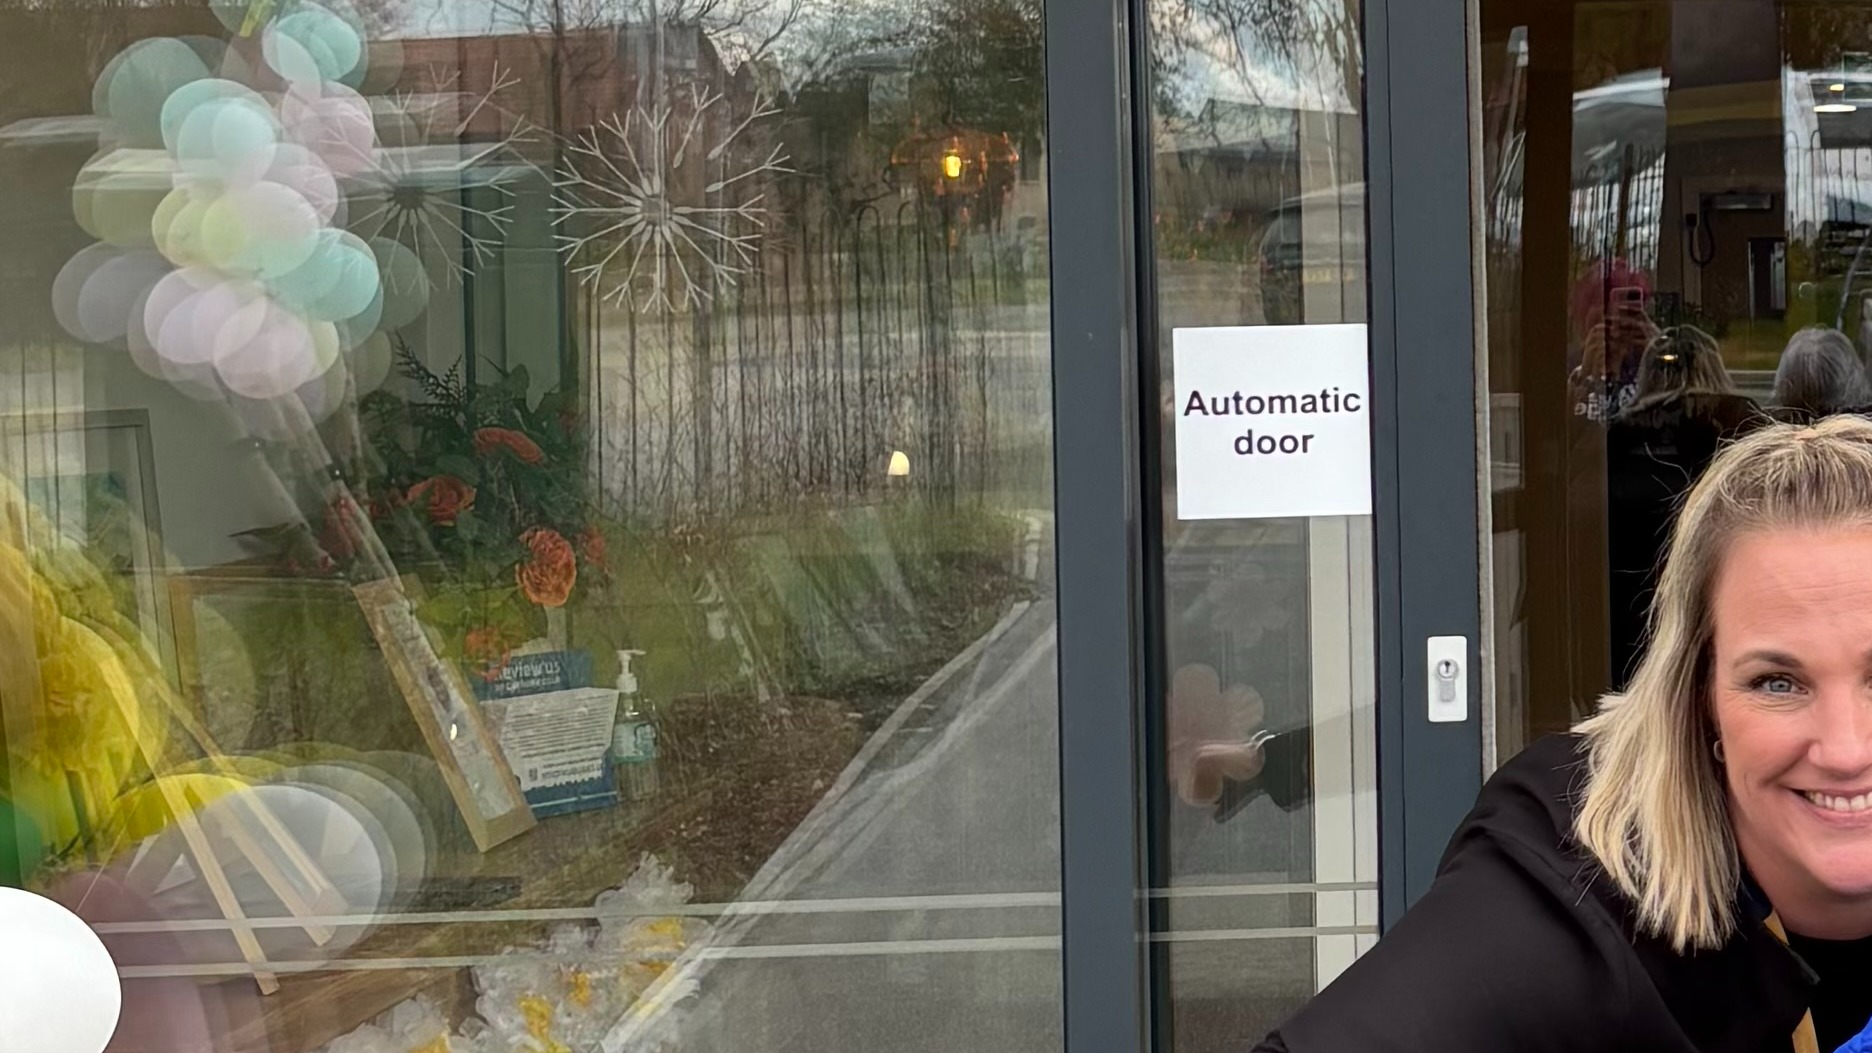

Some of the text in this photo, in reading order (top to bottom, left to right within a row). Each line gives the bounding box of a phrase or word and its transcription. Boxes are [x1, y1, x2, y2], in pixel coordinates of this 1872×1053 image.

[1183, 386, 1362, 417] Automatic
[1233, 429, 1315, 456] door
[495, 660, 542, 681] eview
